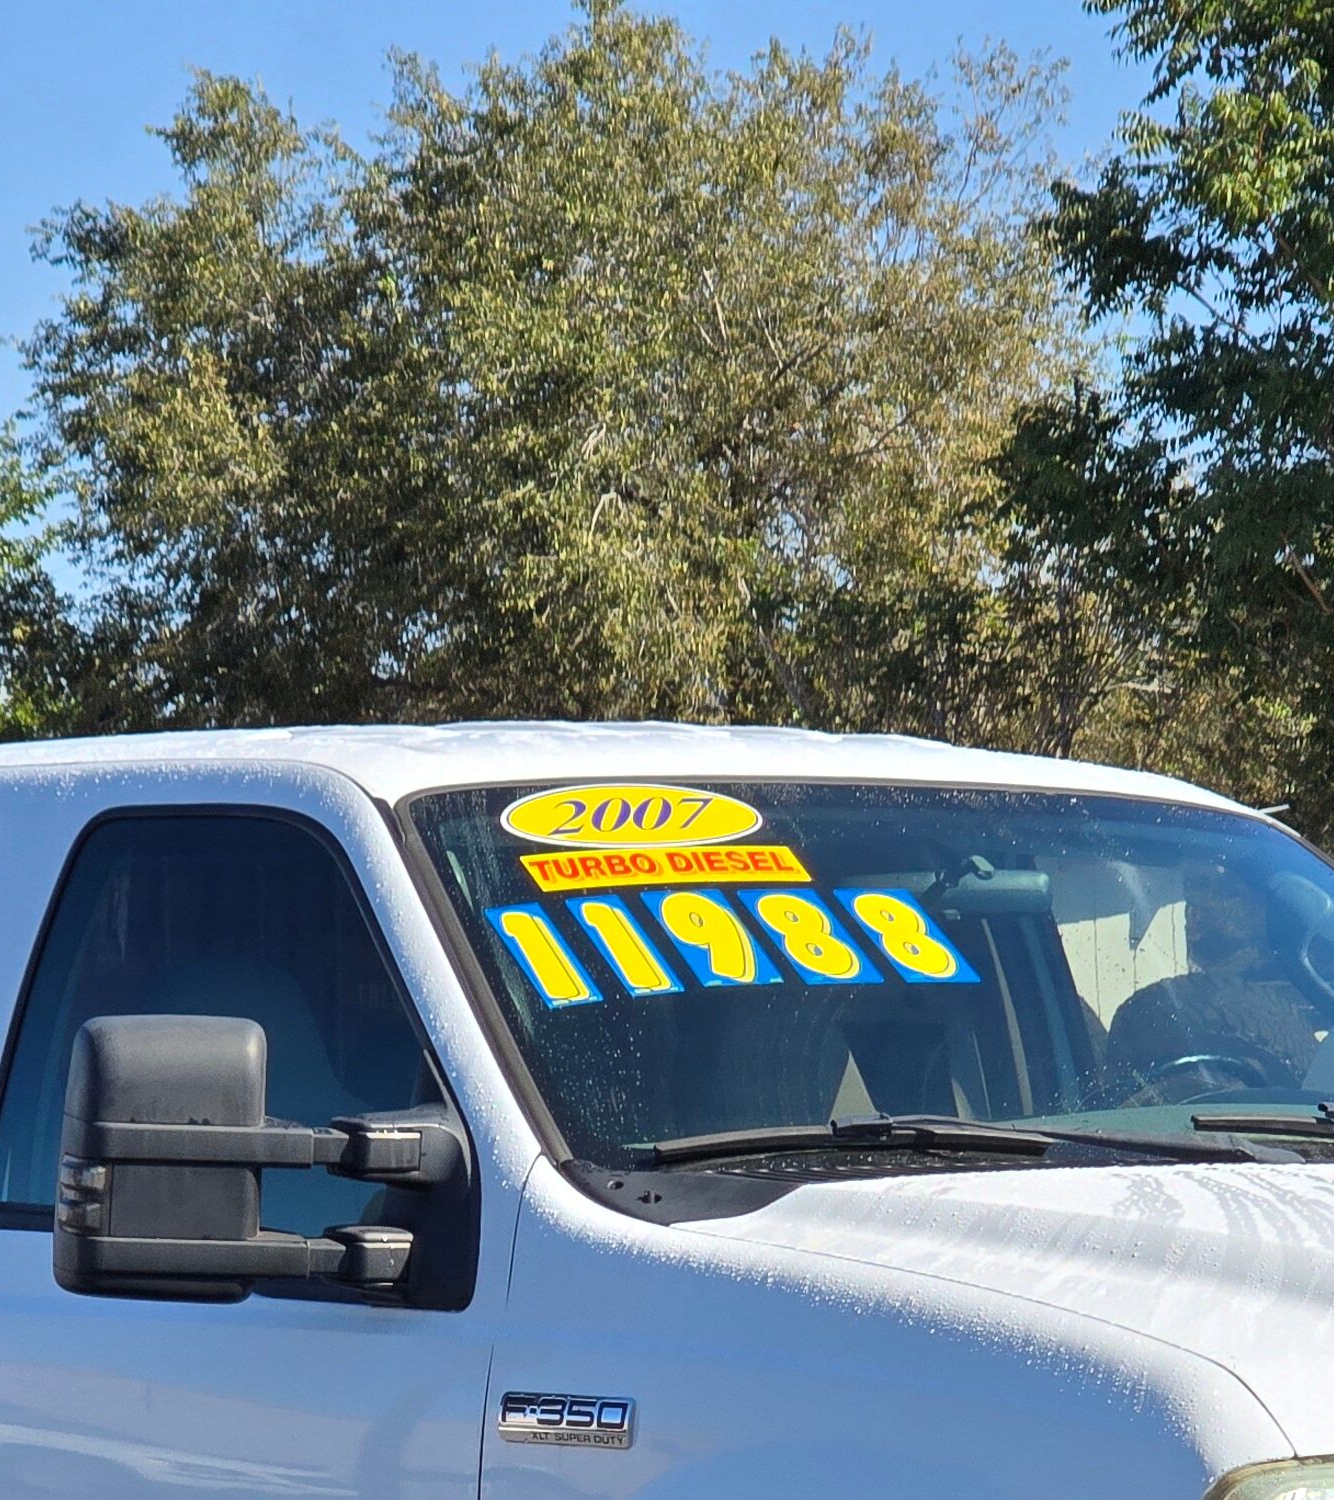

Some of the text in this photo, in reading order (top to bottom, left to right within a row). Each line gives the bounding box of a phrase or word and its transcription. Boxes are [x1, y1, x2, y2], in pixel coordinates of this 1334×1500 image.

[547, 796, 715, 836] 2007
[528, 849, 794, 883] TURBO DIESEL
[500, 891, 957, 1001] 11988
[500, 1395, 629, 1430] F-350
[531, 1432, 624, 1445] XLT SUPER DUTY
